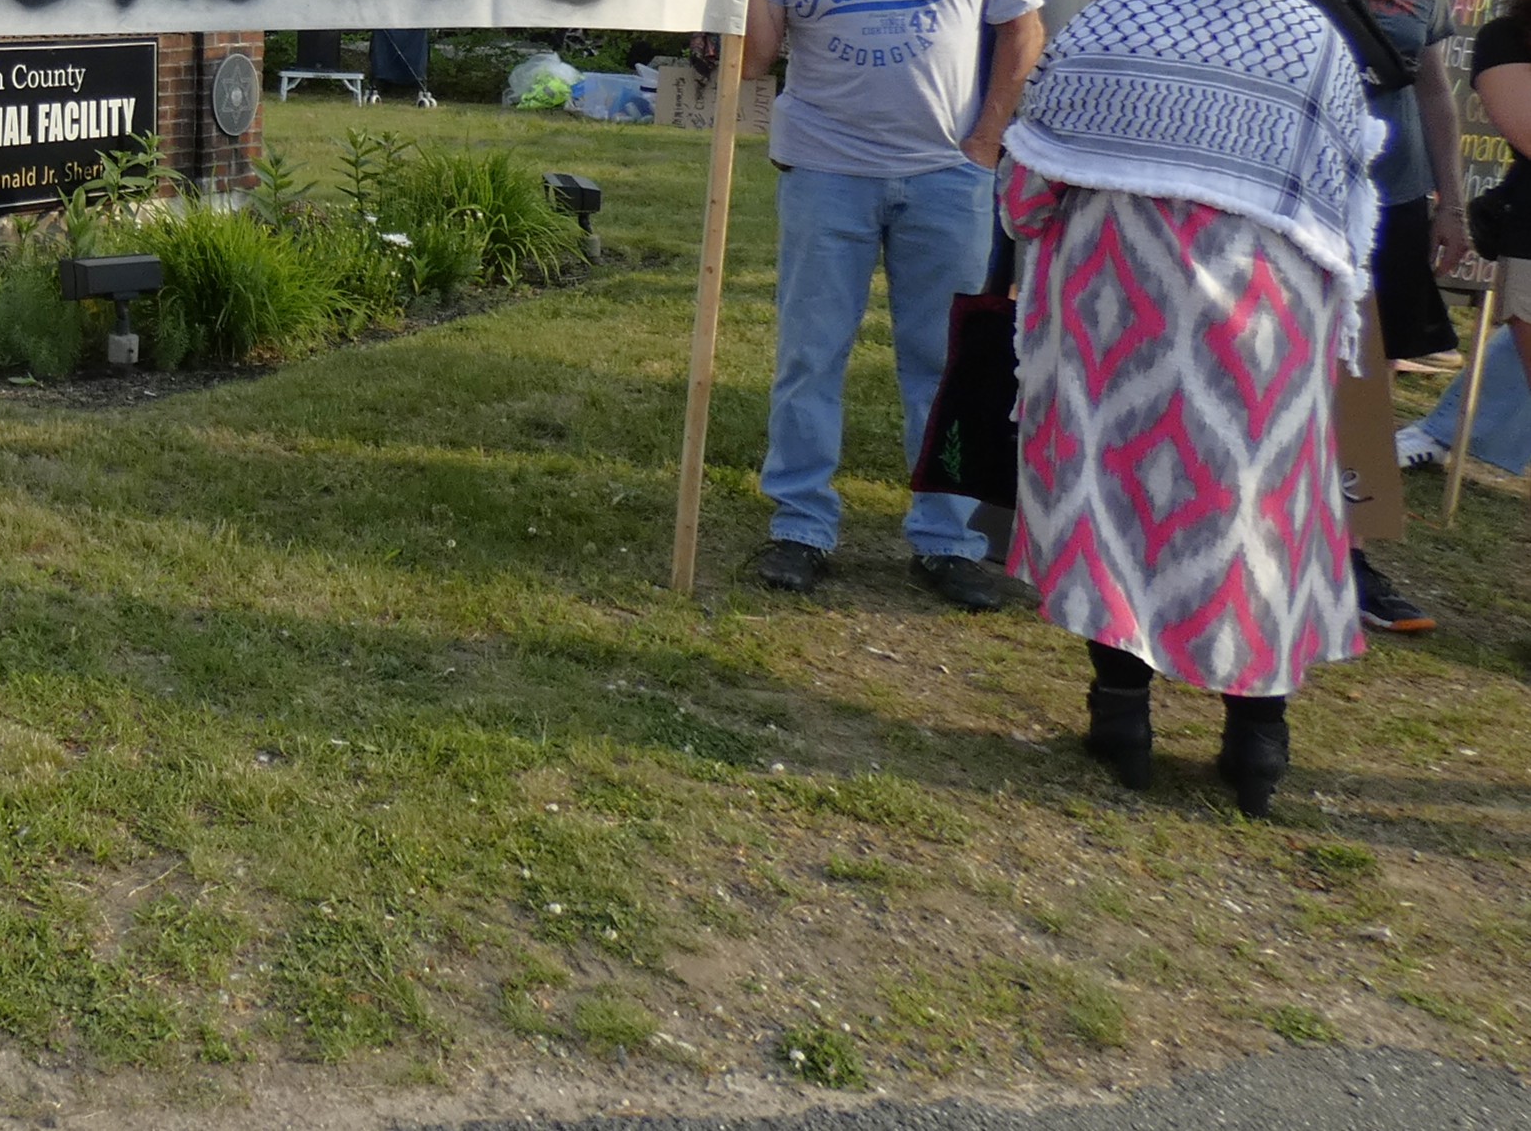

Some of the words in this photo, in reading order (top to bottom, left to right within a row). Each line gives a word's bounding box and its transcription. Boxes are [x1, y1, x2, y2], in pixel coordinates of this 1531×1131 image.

[909, 10, 938, 33] 47
[827, 34, 934, 68] GEORGIA
[11, 63, 86, 93] County
[37, 97, 136, 144] FACILITY
[41, 165, 59, 185] Jr.
